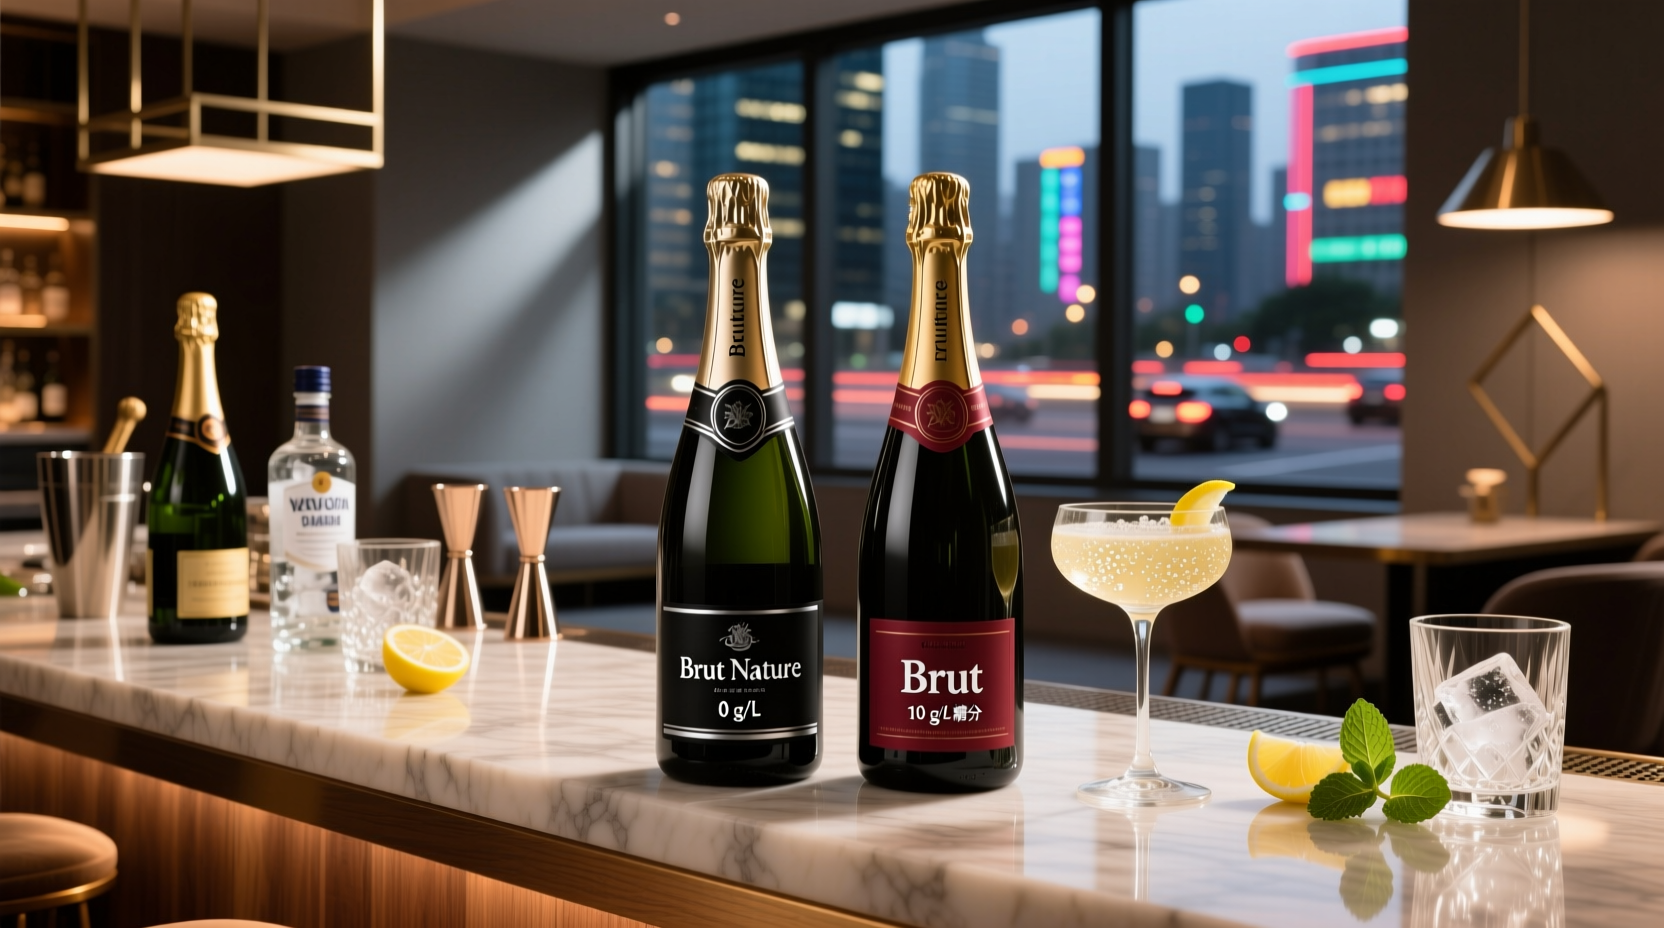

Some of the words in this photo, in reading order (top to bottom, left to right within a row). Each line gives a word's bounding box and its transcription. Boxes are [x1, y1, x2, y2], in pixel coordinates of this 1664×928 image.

[679, 655, 726, 681] Brut
[730, 657, 802, 681] Nature
[900, 659, 984, 694] Brut
[718, 700, 729, 718] 0
[733, 700, 762, 722] g/L
[907, 704, 926, 720] 10
